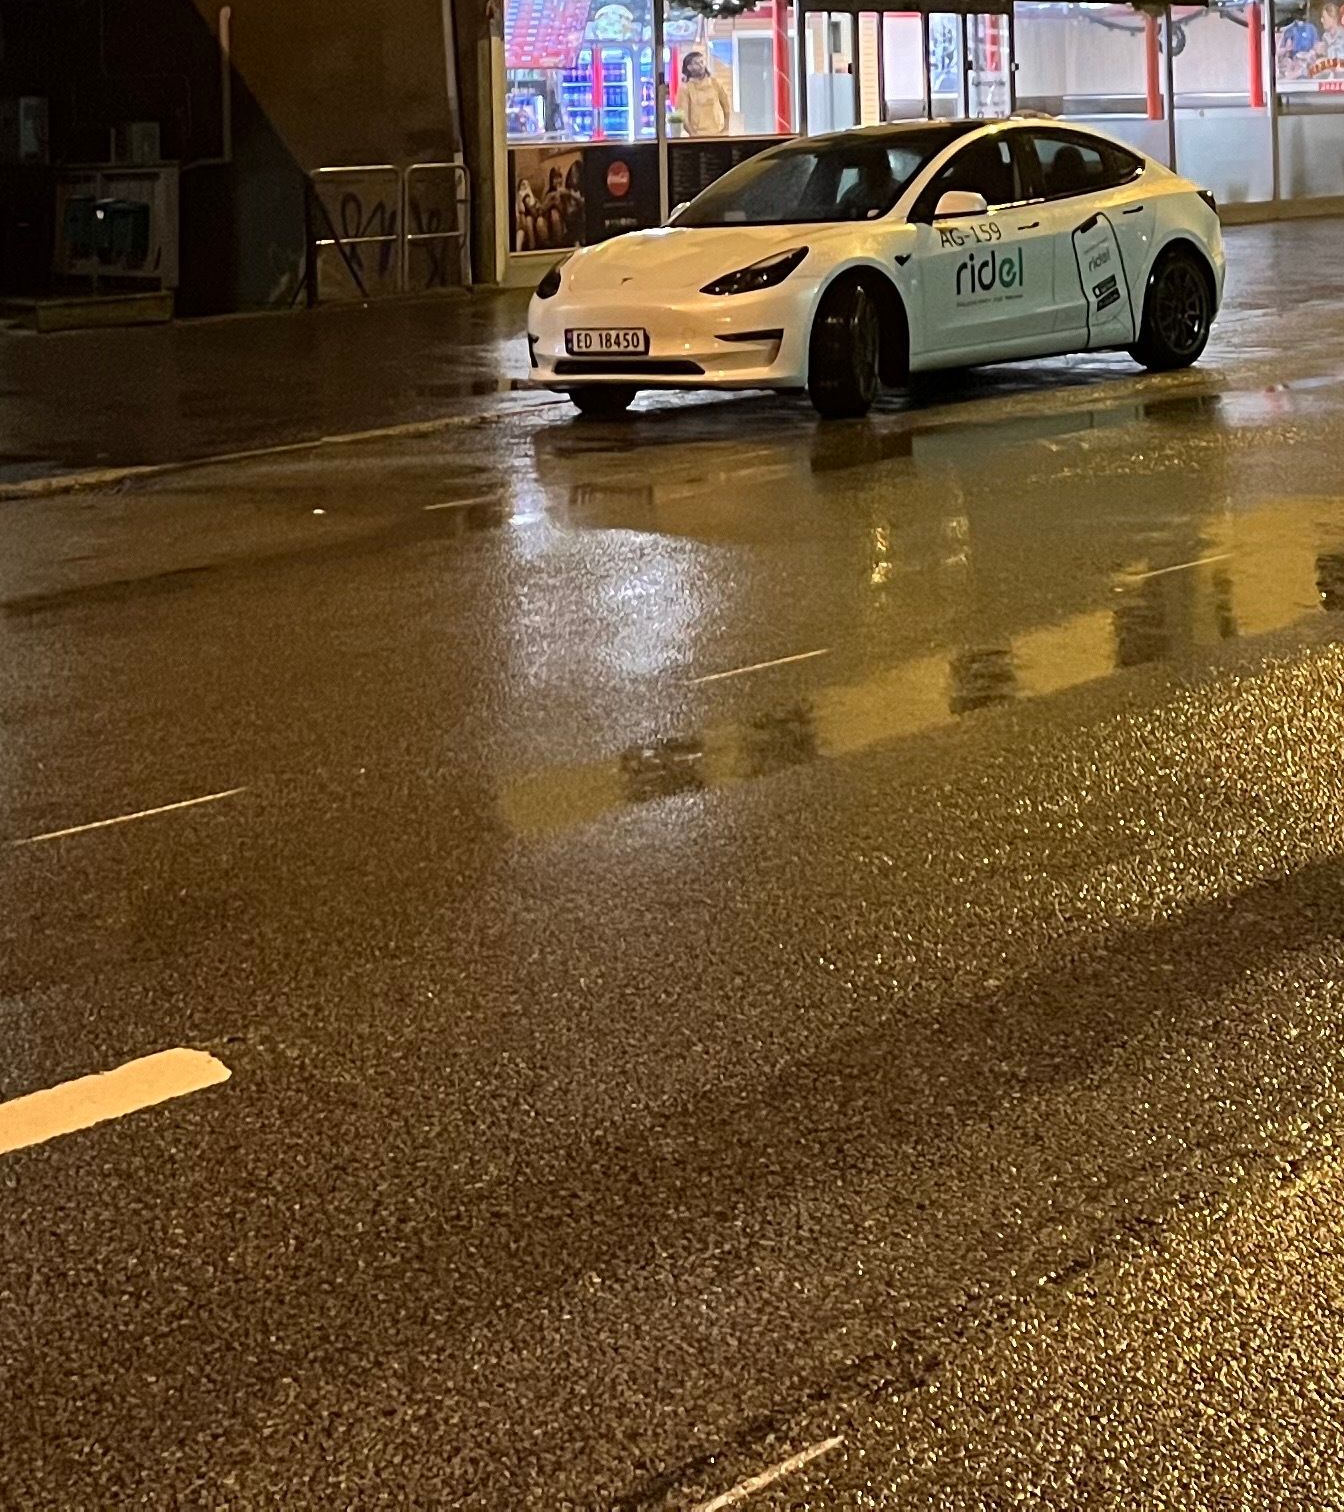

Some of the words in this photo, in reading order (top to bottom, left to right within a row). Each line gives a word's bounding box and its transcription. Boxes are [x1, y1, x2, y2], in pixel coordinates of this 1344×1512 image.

[939, 221, 1002, 248] AG-159
[956, 246, 1023, 296] ridel
[576, 332, 592, 349] ED
[598, 331, 640, 348] 18450
